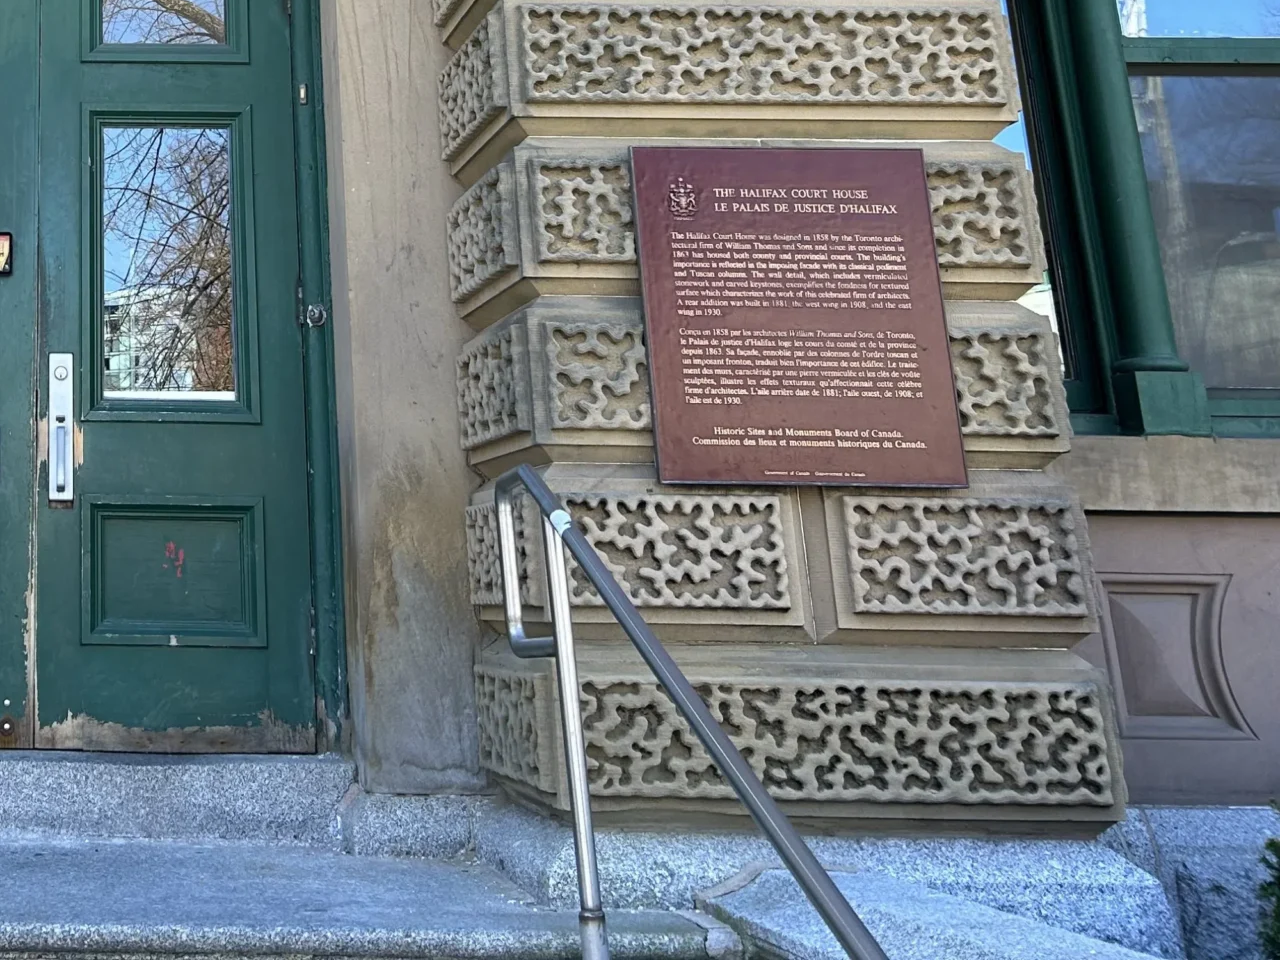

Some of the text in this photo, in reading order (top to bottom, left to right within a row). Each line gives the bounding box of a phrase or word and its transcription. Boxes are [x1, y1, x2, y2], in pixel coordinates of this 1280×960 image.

[713, 188, 868, 199] THE HALIFAX COURT HOUSE
[714, 202, 897, 214] LE PALAIS DE JUSTICE D'HALIFAX
[671, 231, 684, 239] The
[813, 233, 828, 241] 1858
[841, 233, 852, 241] the
[855, 234, 882, 242] Toronto
[699, 241, 713, 249] firm
[725, 241, 751, 249] William
[754, 242, 780, 250] Thomas
[814, 242, 827, 250] and
[692, 250, 703, 258] has
[706, 250, 730, 258] housed
[733, 251, 749, 259] both
[752, 251, 775, 261] county
[691, 269, 714, 277] Tuscan
[752, 270, 764, 278] The
[768, 270, 782, 278] wall
[809, 271, 830, 279] which
[711, 279, 724, 287] and
[725, 279, 748, 287] carved
[700, 288, 720, 296] which
[777, 289, 794, 297] work
[804, 290, 816, 298] this
[897, 301, 912, 309] east
[677, 307, 694, 317] wing
[876, 330, 884, 338] de
[688, 337, 708, 345] Palais
[710, 337, 718, 345] de
[720, 338, 742, 348] justice
[744, 338, 775, 346] d'Halifax
[859, 340, 866, 348] et
[868, 340, 876, 348] de
[878, 340, 884, 348] la
[680, 347, 703, 356] depuis
[725, 347, 734, 355] Sa
[779, 358, 794, 366] bien
[887, 360, 896, 368] Le
[759, 377, 778, 385] effets
[750, 387, 769, 395] L'aile
[795, 388, 810, 396] date
[811, 388, 819, 396] de
[702, 396, 712, 404] est
[713, 396, 722, 404] de
[714, 426, 903, 438] Historic Sites and Monuments Board of Canada.
[692, 436, 927, 450] Commission des lieux et monuments historiques du Canada.
